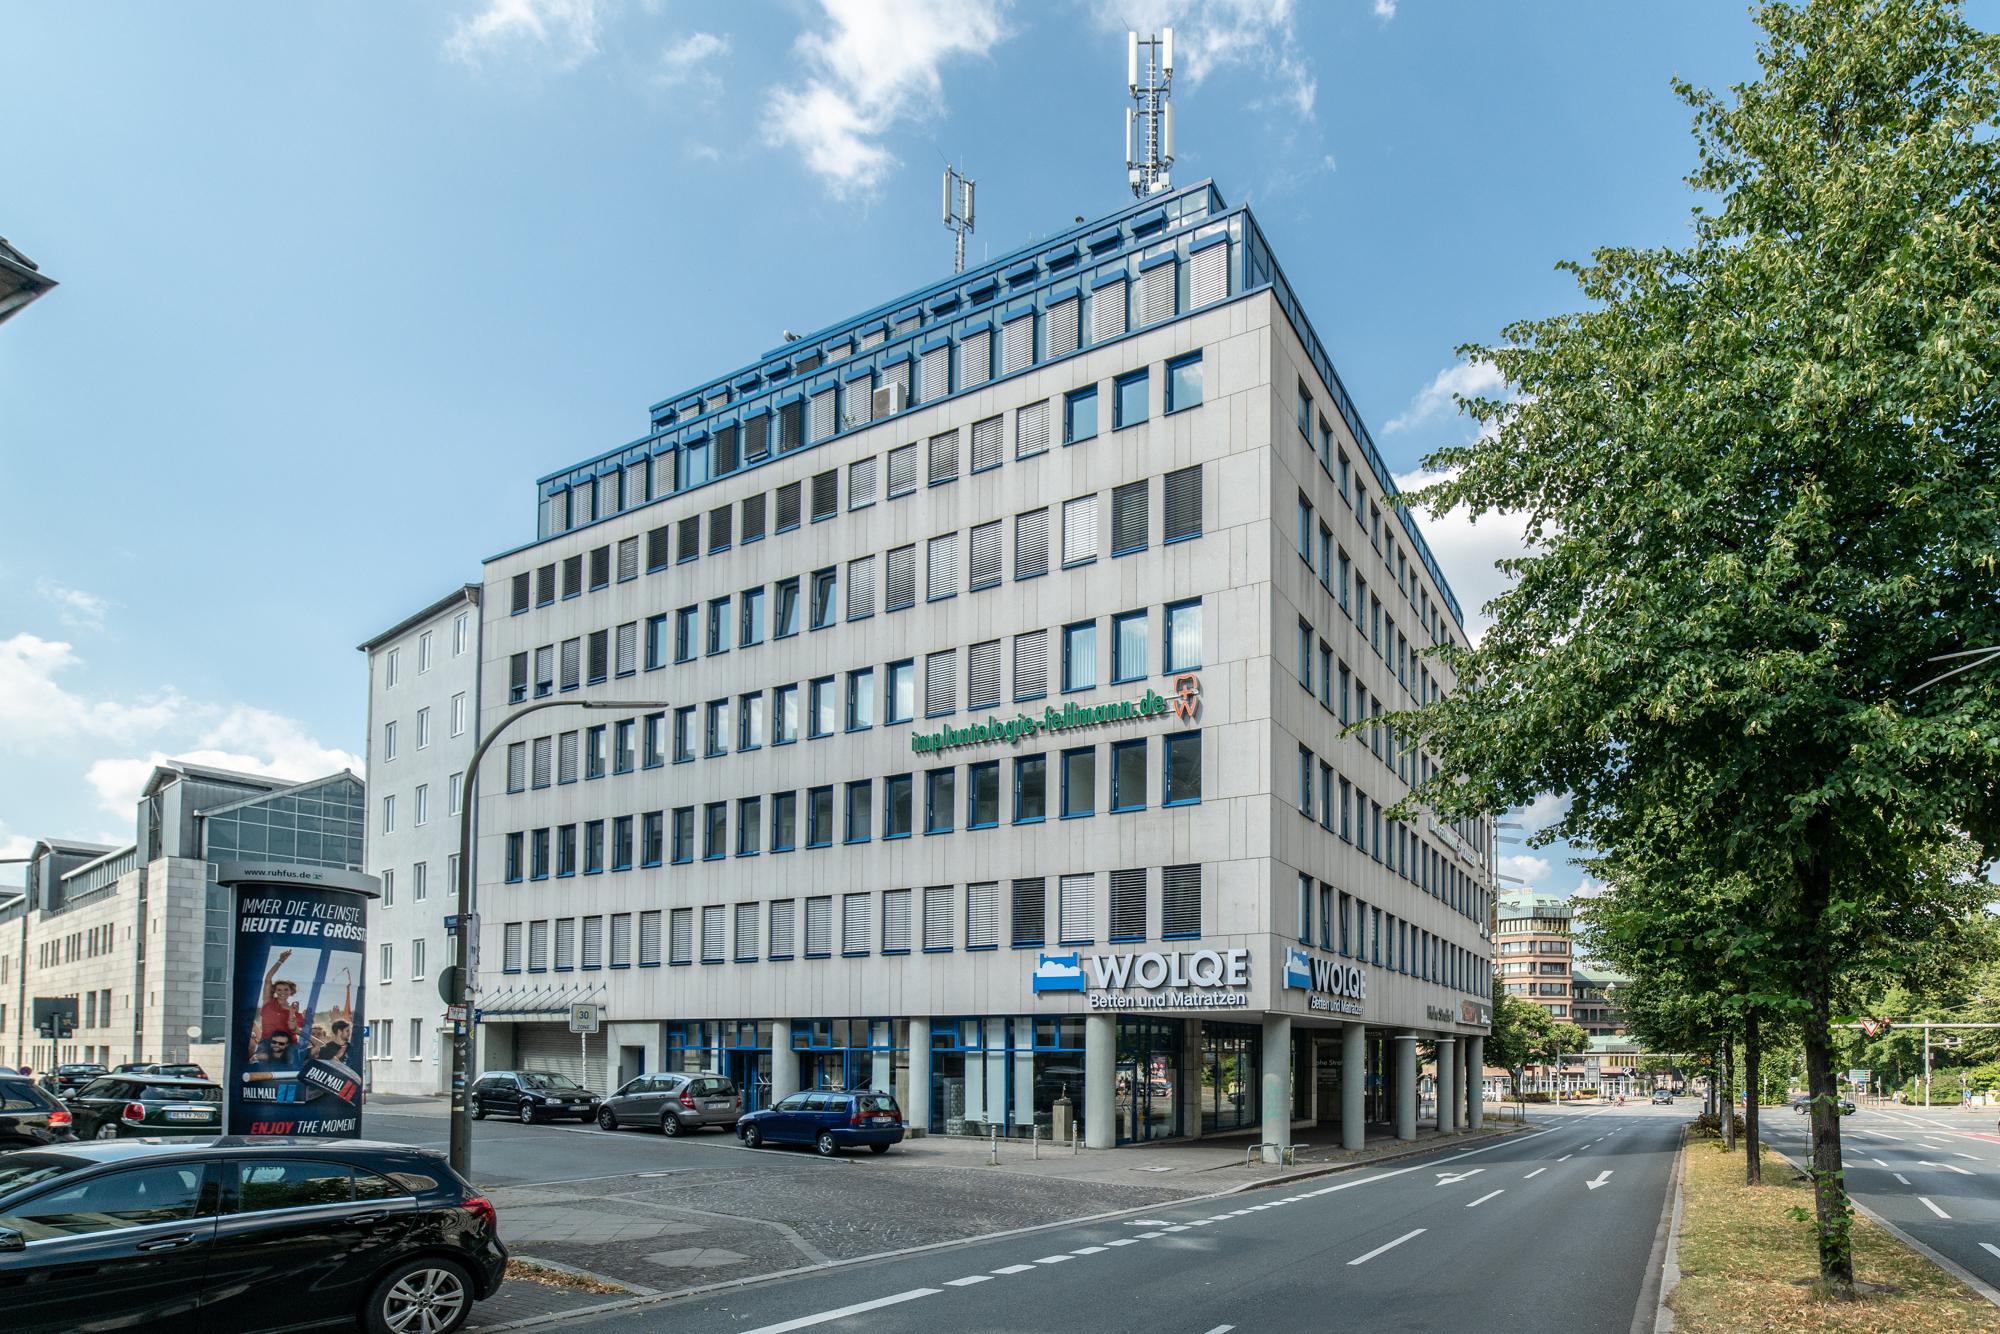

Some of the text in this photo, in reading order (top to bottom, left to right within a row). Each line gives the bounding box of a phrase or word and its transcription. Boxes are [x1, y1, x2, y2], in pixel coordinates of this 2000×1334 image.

[911, 689, 1166, 752] implantologie-fellmann.de
[244, 868, 311, 879] www.ruhfus.de
[242, 898, 360, 923] IMMER DIE KLEINSTE
[241, 917, 289, 933] HEUTE
[291, 920, 321, 936] DIE
[1091, 948, 1248, 989] WOLQE
[1312, 957, 1366, 1000] WOLQE
[1089, 991, 1246, 1008] Betten und Matratzen
[1311, 995, 1365, 1015] Betten und Matratzen
[579, 1010, 589, 1020] 30
[305, 1066, 344, 1092] PALL MALL
[243, 1087, 277, 1100] PALL MALL
[250, 1118, 357, 1135] ENJOY THE MOMENT
